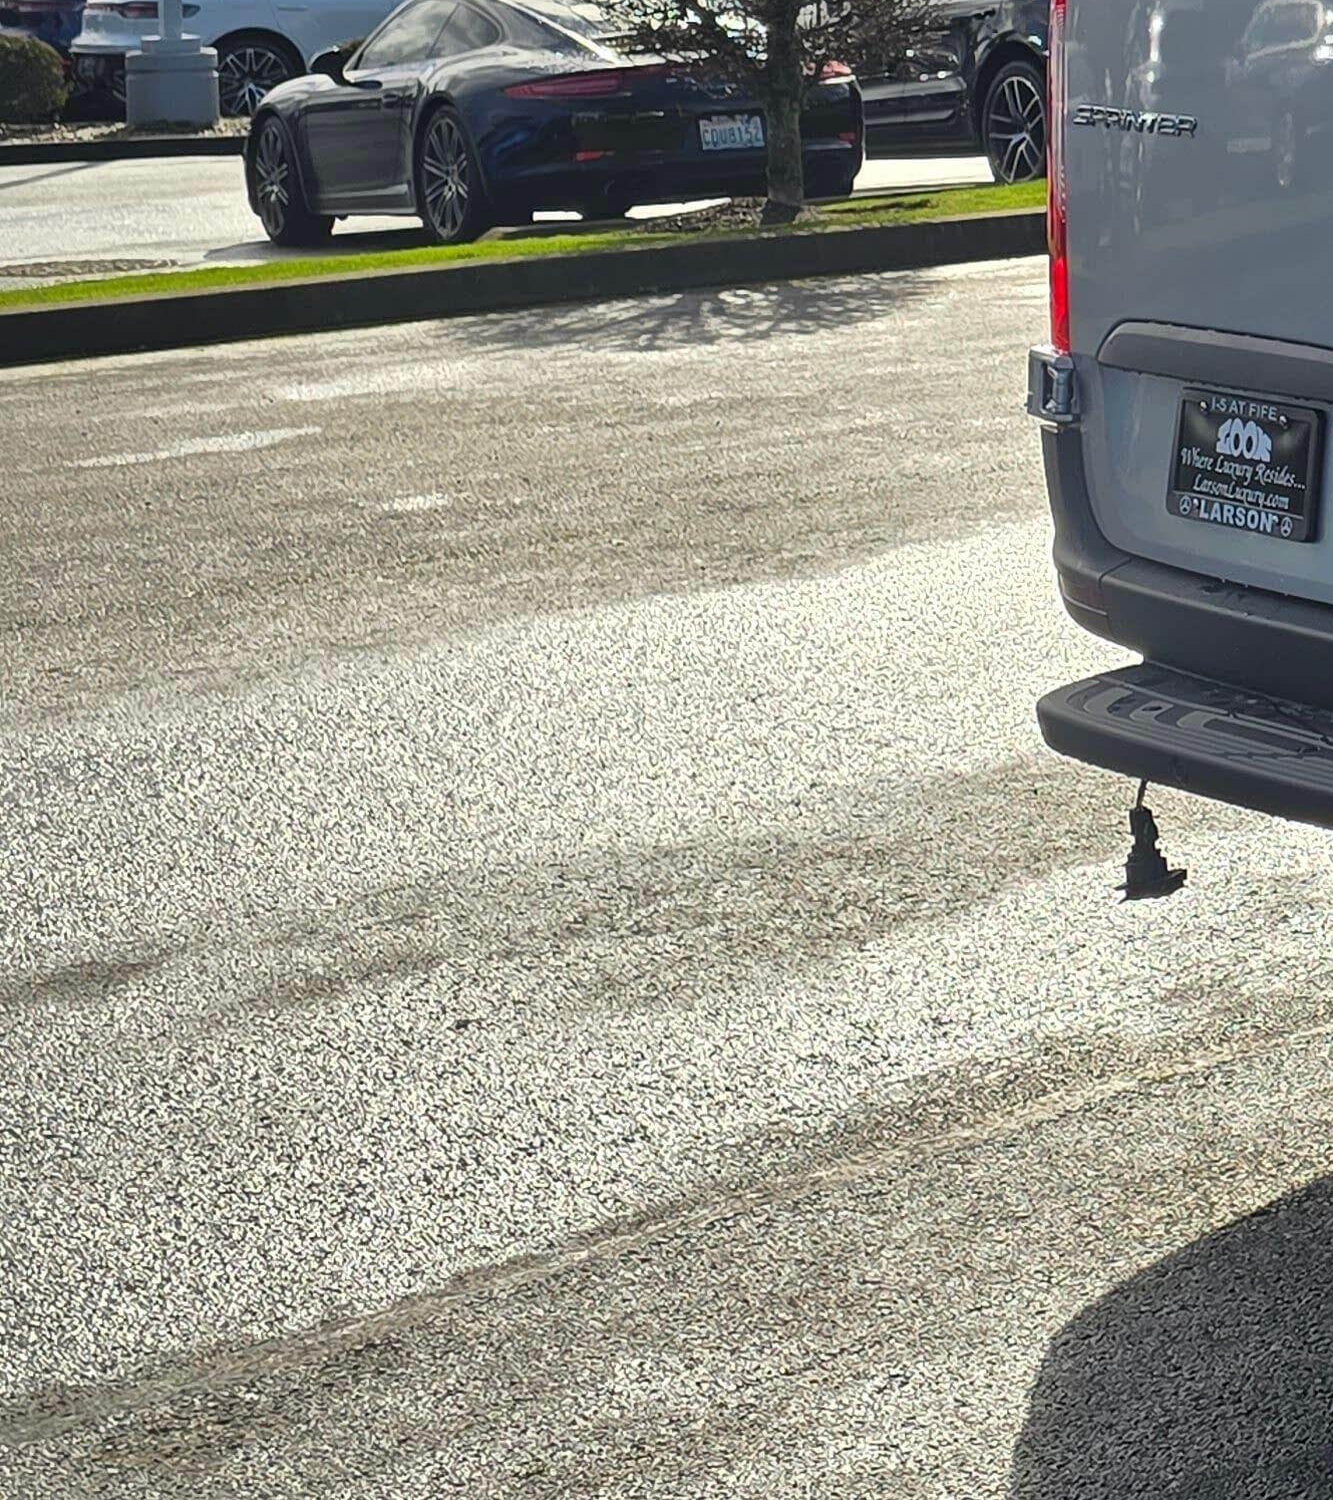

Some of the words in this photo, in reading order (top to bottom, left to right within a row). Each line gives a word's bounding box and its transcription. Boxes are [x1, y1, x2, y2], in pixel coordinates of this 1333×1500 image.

[1073, 104, 1197, 138] SPRINTER
[1229, 400, 1246, 414] AT
[1249, 403, 1279, 422] FIFE
[1181, 447, 1214, 470] Where
[1215, 455, 1253, 485] Luxury
[1199, 499, 1274, 533] LARSON
